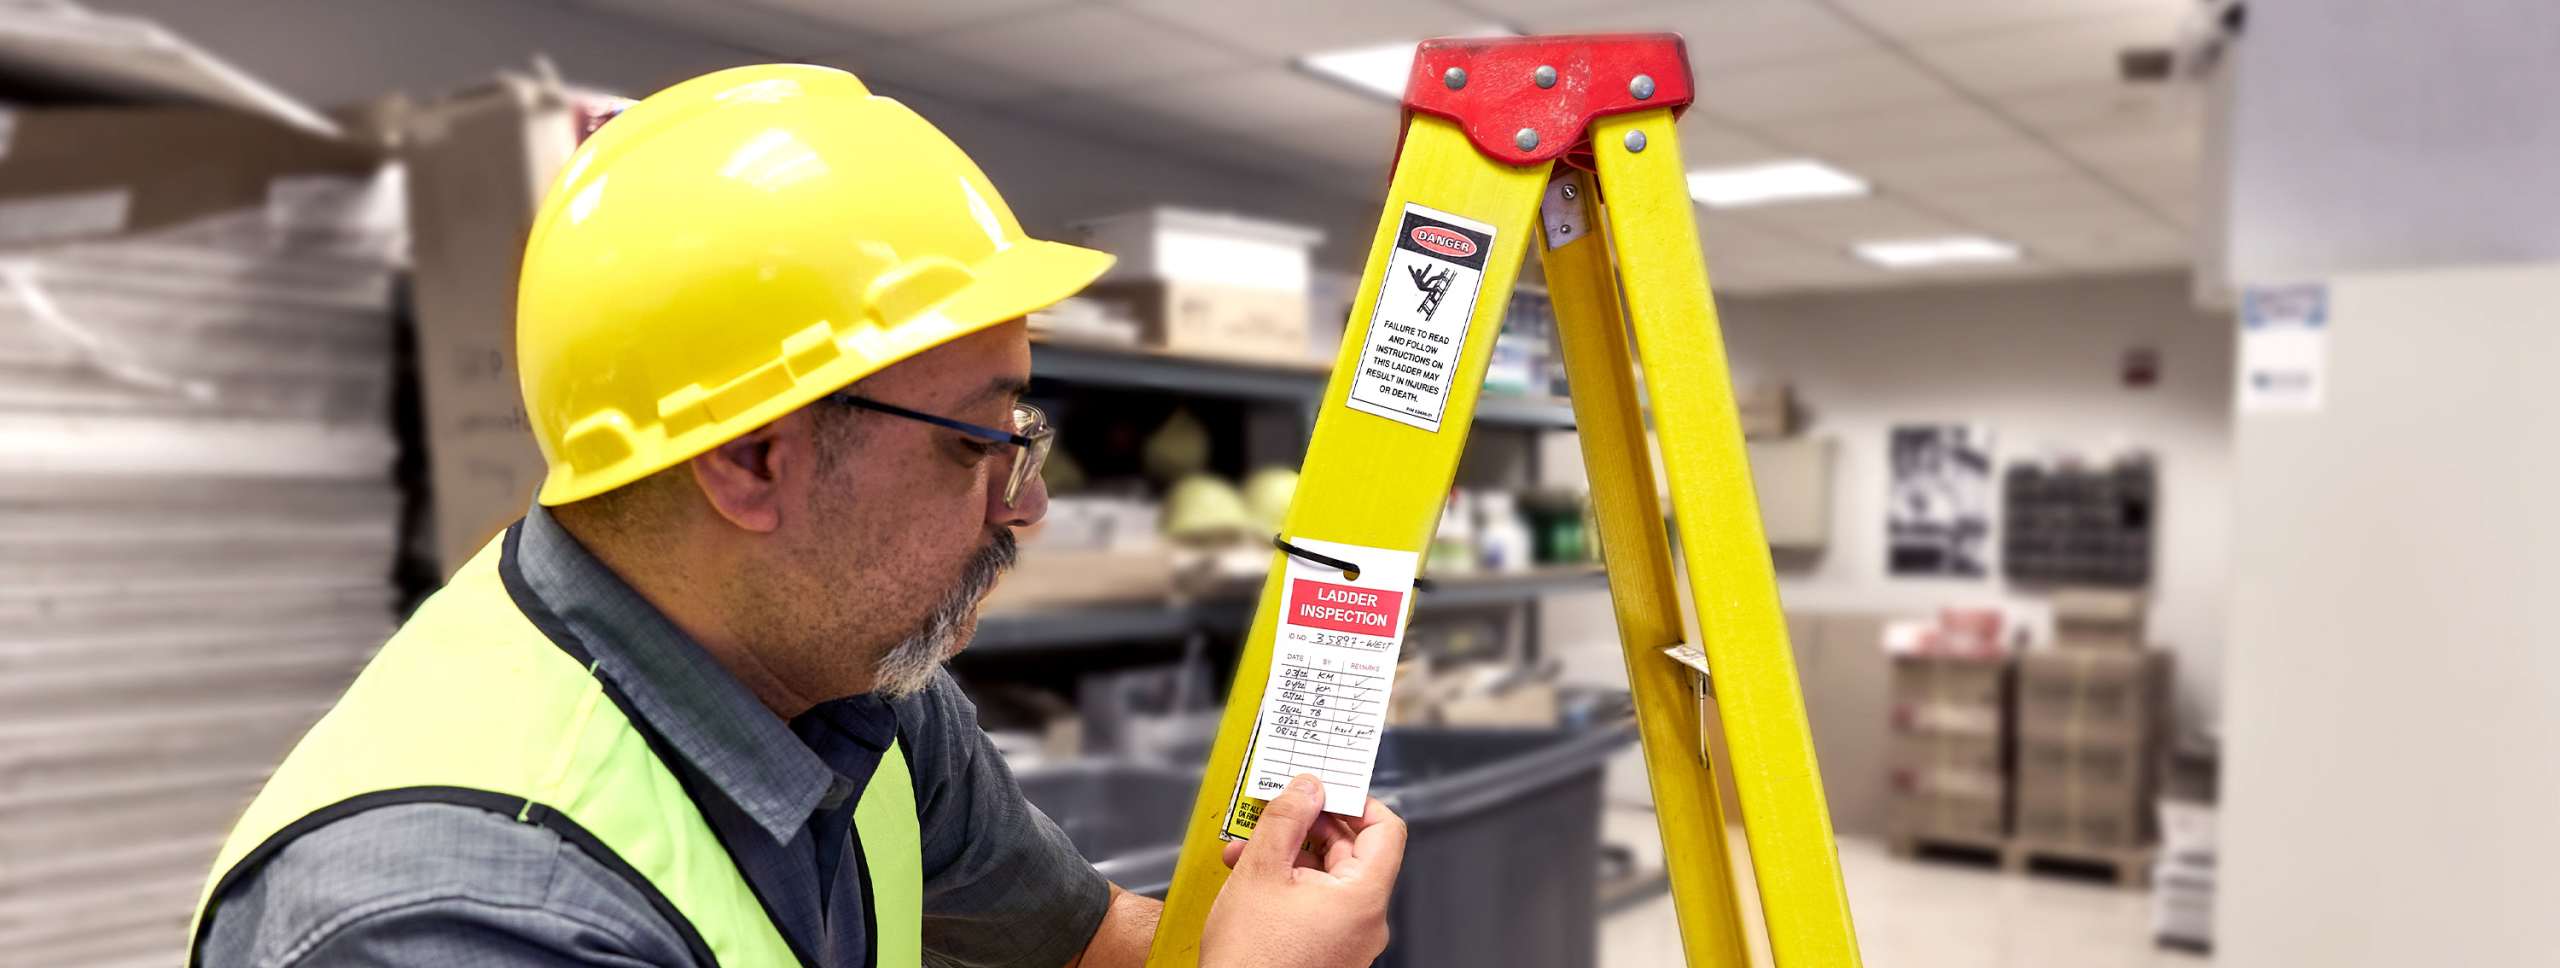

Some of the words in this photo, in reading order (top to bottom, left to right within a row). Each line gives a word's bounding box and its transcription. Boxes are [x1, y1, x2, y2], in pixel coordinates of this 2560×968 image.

[1418, 231, 1470, 252] DANGER
[1384, 320, 1416, 335] FAILURE
[1417, 329, 1427, 338] TO
[1428, 332, 1450, 345] READ
[1388, 335, 1405, 345] AND
[1406, 339, 1438, 354] FOLLOW
[1376, 344, 1431, 366] INSTRUCTIONS
[1431, 360, 1443, 369] ON
[1374, 356, 1391, 368] THIS
[1391, 362, 1422, 376] LADDER
[1423, 371, 1440, 381] MAY
[1366, 368, 1395, 382] RESULT
[1396, 377, 1404, 385] IN
[1405, 379, 1440, 395] INJURIES
[1380, 385, 1391, 394] OR
[1392, 388, 1418, 402] DEATH.
[1317, 588, 1378, 607] LADDER
[1300, 603, 1388, 627] INSPECTION
[1287, 653, 1304, 661] DATE
[1317, 671, 1334, 681] KM
[1310, 708, 1321, 717] TB
[1238, 810, 1247, 818] ON
[1240, 802, 1250, 810] SET
[1250, 804, 1259, 814] ALL
[1236, 819, 1250, 829] WEAR
